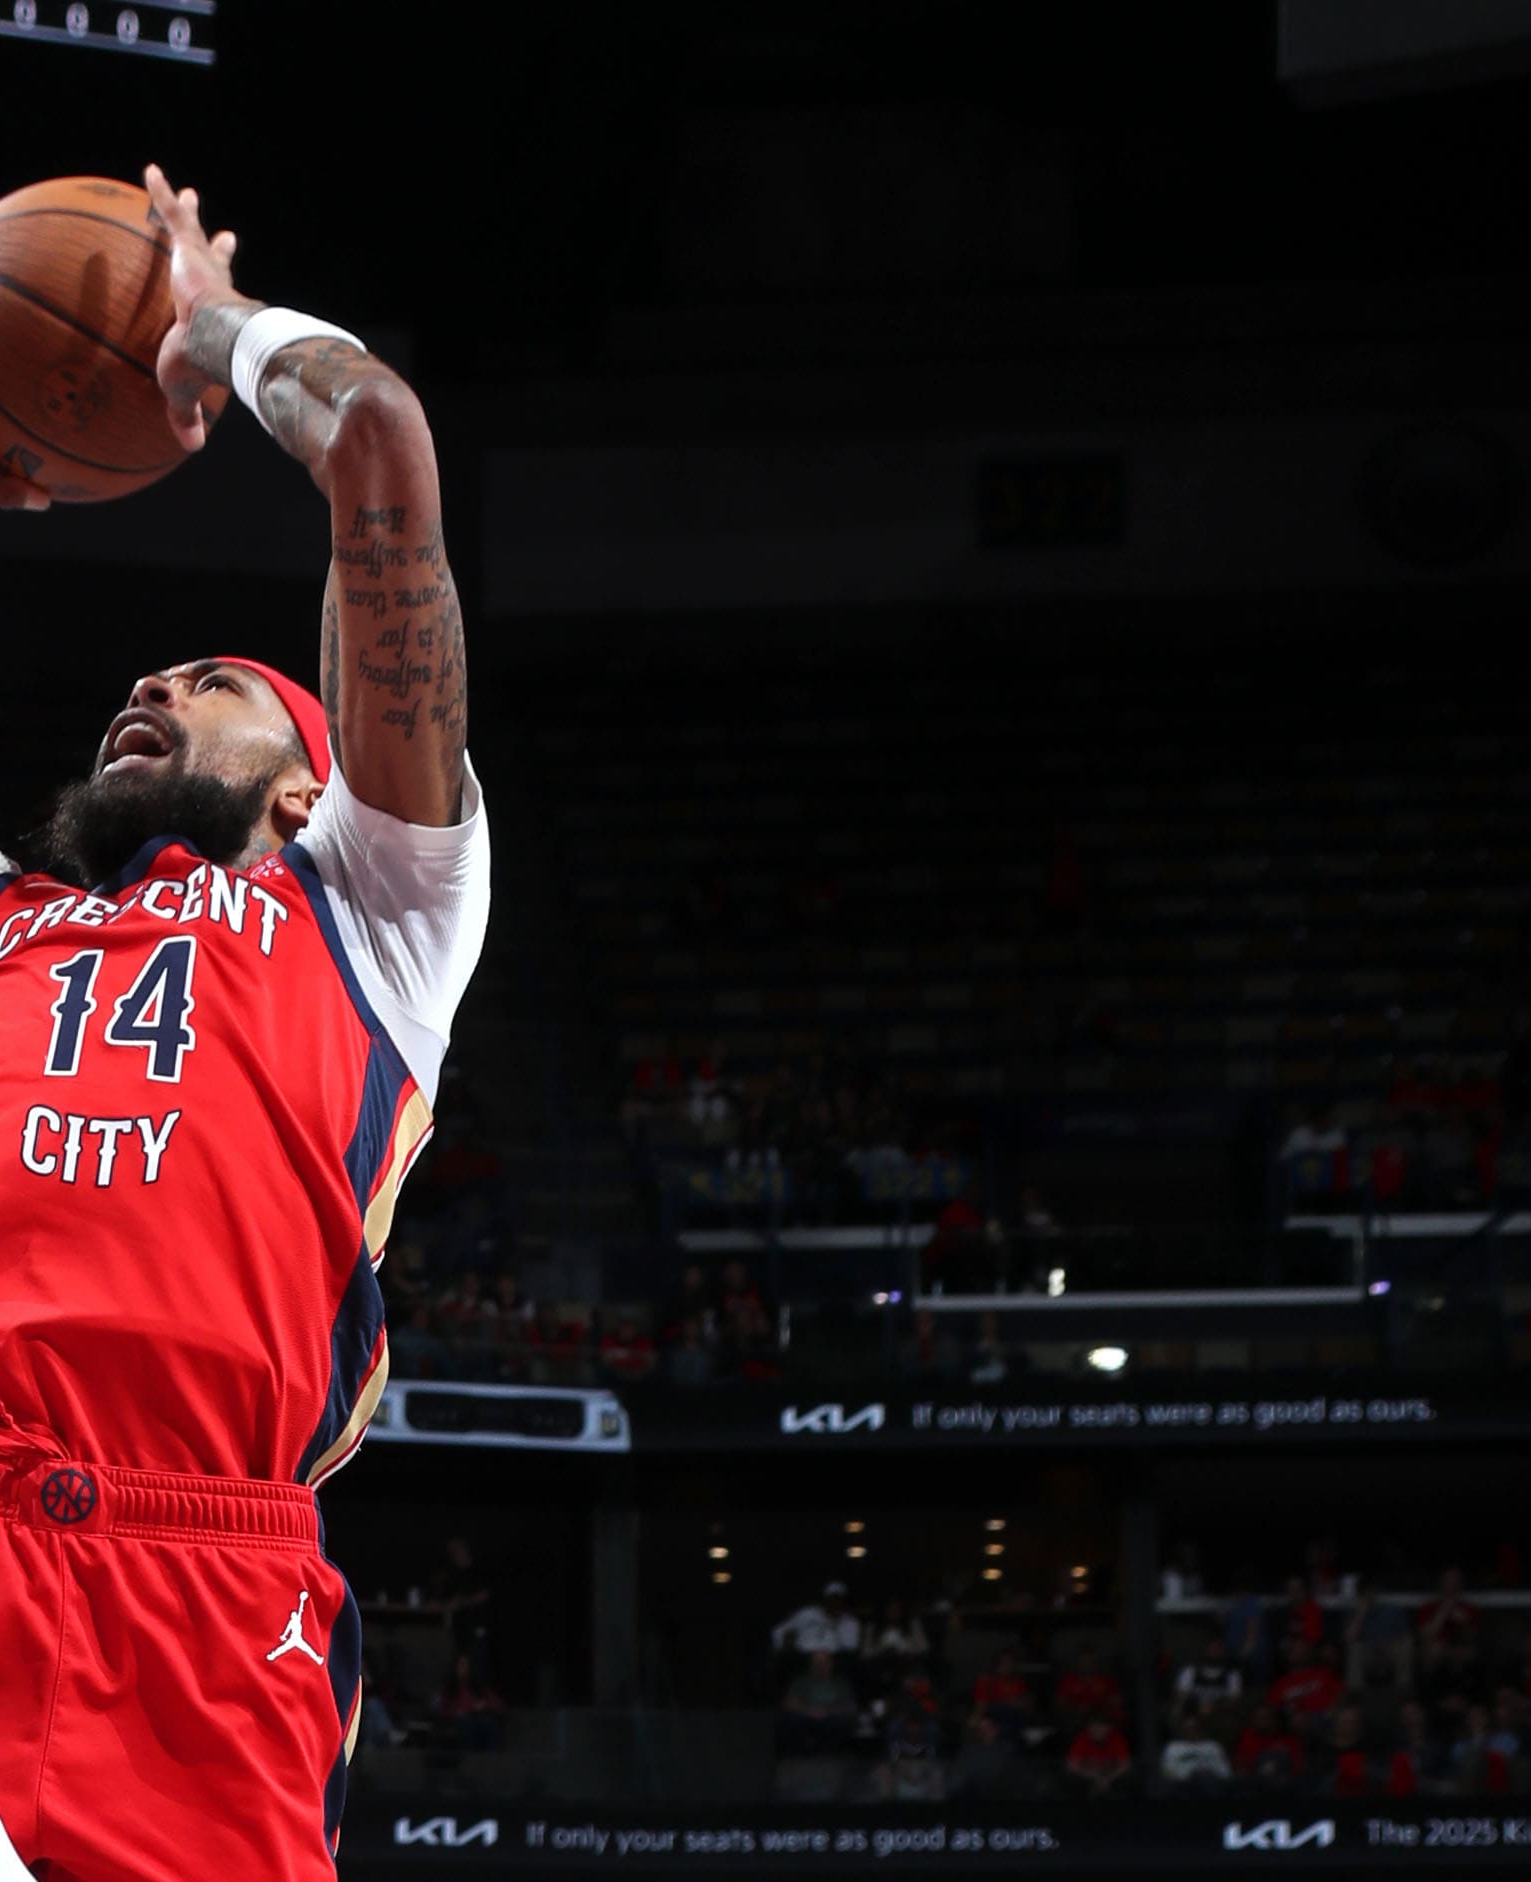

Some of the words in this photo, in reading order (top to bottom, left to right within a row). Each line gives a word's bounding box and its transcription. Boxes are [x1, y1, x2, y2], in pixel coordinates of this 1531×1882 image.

[66, 2, 89, 38] 0
[117, 9, 140, 45] 0
[168, 16, 191, 52] 0
[377, 618, 410, 659] far
[417, 627, 433, 655] is
[358, 648, 431, 699] suffering
[44, 934, 196, 1083] 14
[21, 1104, 182, 1188] CITY
[780, 1401, 886, 1434] KIA
[936, 1401, 999, 1436] only
[1000, 1404, 1063, 1433] your
[1069, 1401, 1141, 1428] seats
[1143, 1401, 1213, 1427] were
[1215, 1402, 1251, 1426] as
[1253, 1396, 1327, 1431] good
[1329, 1399, 1365, 1424] as
[393, 1816, 499, 1847] KIA
[550, 1823, 611, 1855] only
[616, 1829, 679, 1856] your
[683, 1827, 756, 1852] seats
[759, 1828, 830, 1852] were
[834, 1827, 868, 1852] as
[872, 1823, 946, 1857] good
[950, 1826, 985, 1851] as
[1222, 1816, 1337, 1851] KIA
[1365, 1817, 1420, 1847] The
[1423, 1816, 1500, 1848] 2025
